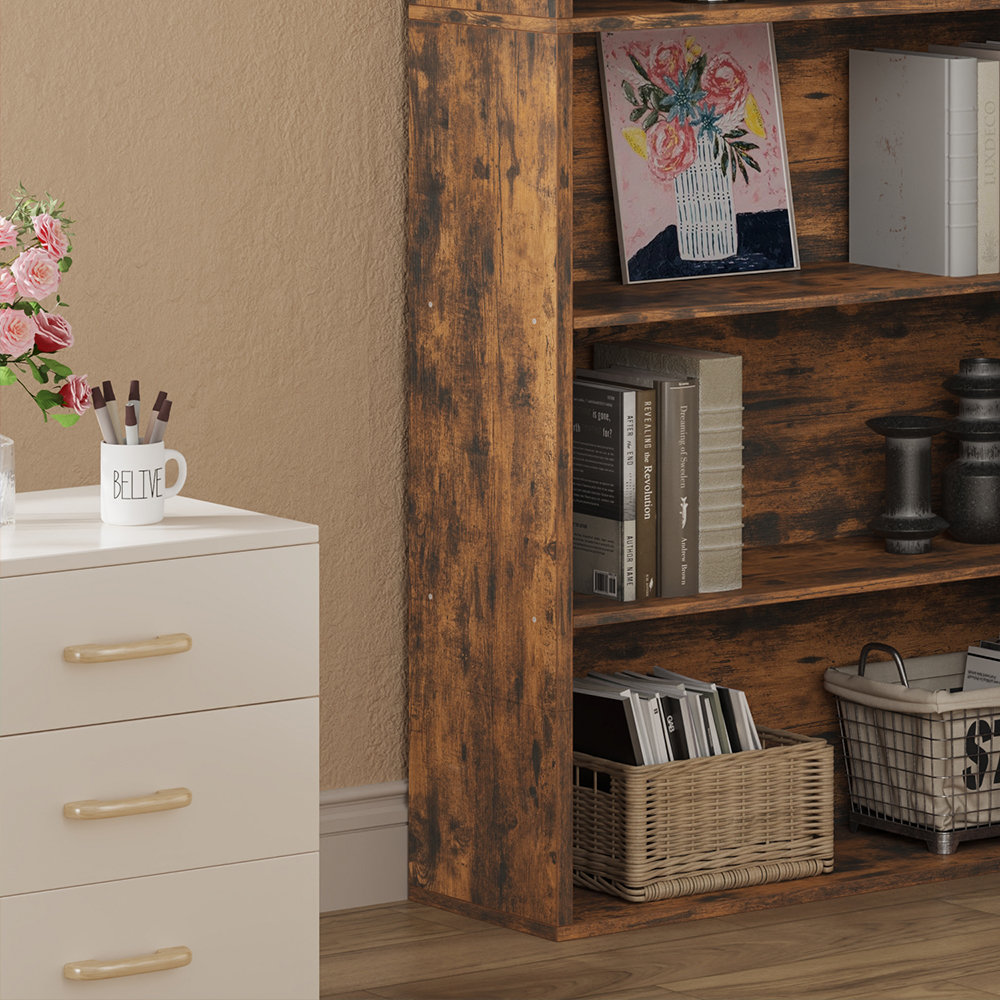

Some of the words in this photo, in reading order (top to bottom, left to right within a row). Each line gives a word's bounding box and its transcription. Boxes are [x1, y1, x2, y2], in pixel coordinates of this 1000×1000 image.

[626, 415, 634, 437] AFTER
[643, 401, 652, 449] REVEALING
[679, 405, 688, 445] Dreaming
[626, 451, 634, 466] END
[644, 452, 652, 463] the
[680, 447, 688, 455] of
[113, 467, 163, 500] BELIVE
[680, 457, 688, 489] Sweden
[643, 465, 653, 520] Revolution
[626, 535, 634, 563] AUTHOR
[680, 537, 688, 562] Andrew
[626, 566, 634, 586] NAME
[680, 564, 688, 586] Brown
